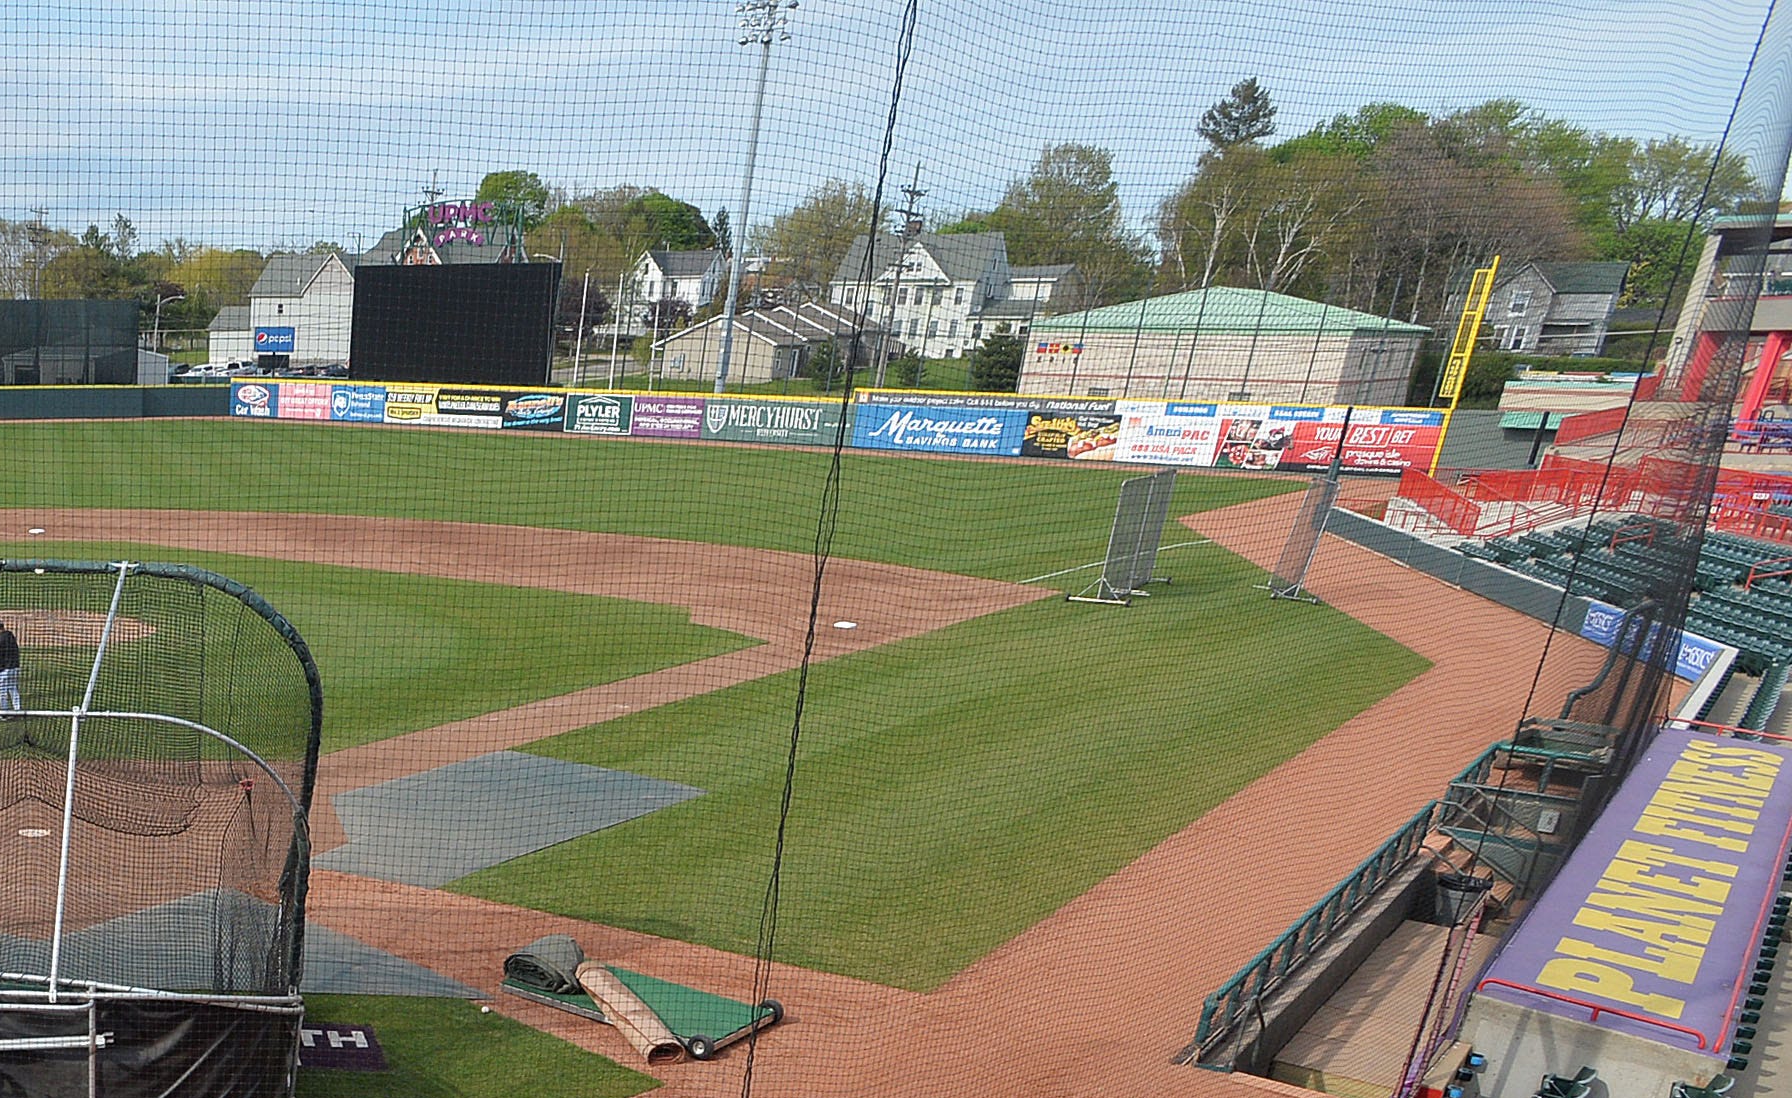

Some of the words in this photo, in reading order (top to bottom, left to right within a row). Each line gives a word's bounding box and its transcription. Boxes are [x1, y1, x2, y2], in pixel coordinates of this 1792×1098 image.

[428, 202, 494, 224] UPMC
[438, 230, 478, 243] PARK
[268, 334, 292, 344] pepsi
[577, 405, 620, 418] PLYLER
[634, 402, 664, 413] UPMC
[1046, 401, 1087, 410] National
[1088, 402, 1113, 411] Fuel
[728, 404, 823, 430] MERCYHURST
[868, 410, 1004, 444] Marquette
[906, 436, 957, 447] SAVINGS
[1349, 427, 1390, 445] BEST
[1391, 430, 1417, 444] BET
[962, 438, 999, 449] BANK
[1152, 445, 1170, 453] USA
[1632, 740, 1784, 853] FITNESS
[1535, 838, 1739, 1019] PLANET
